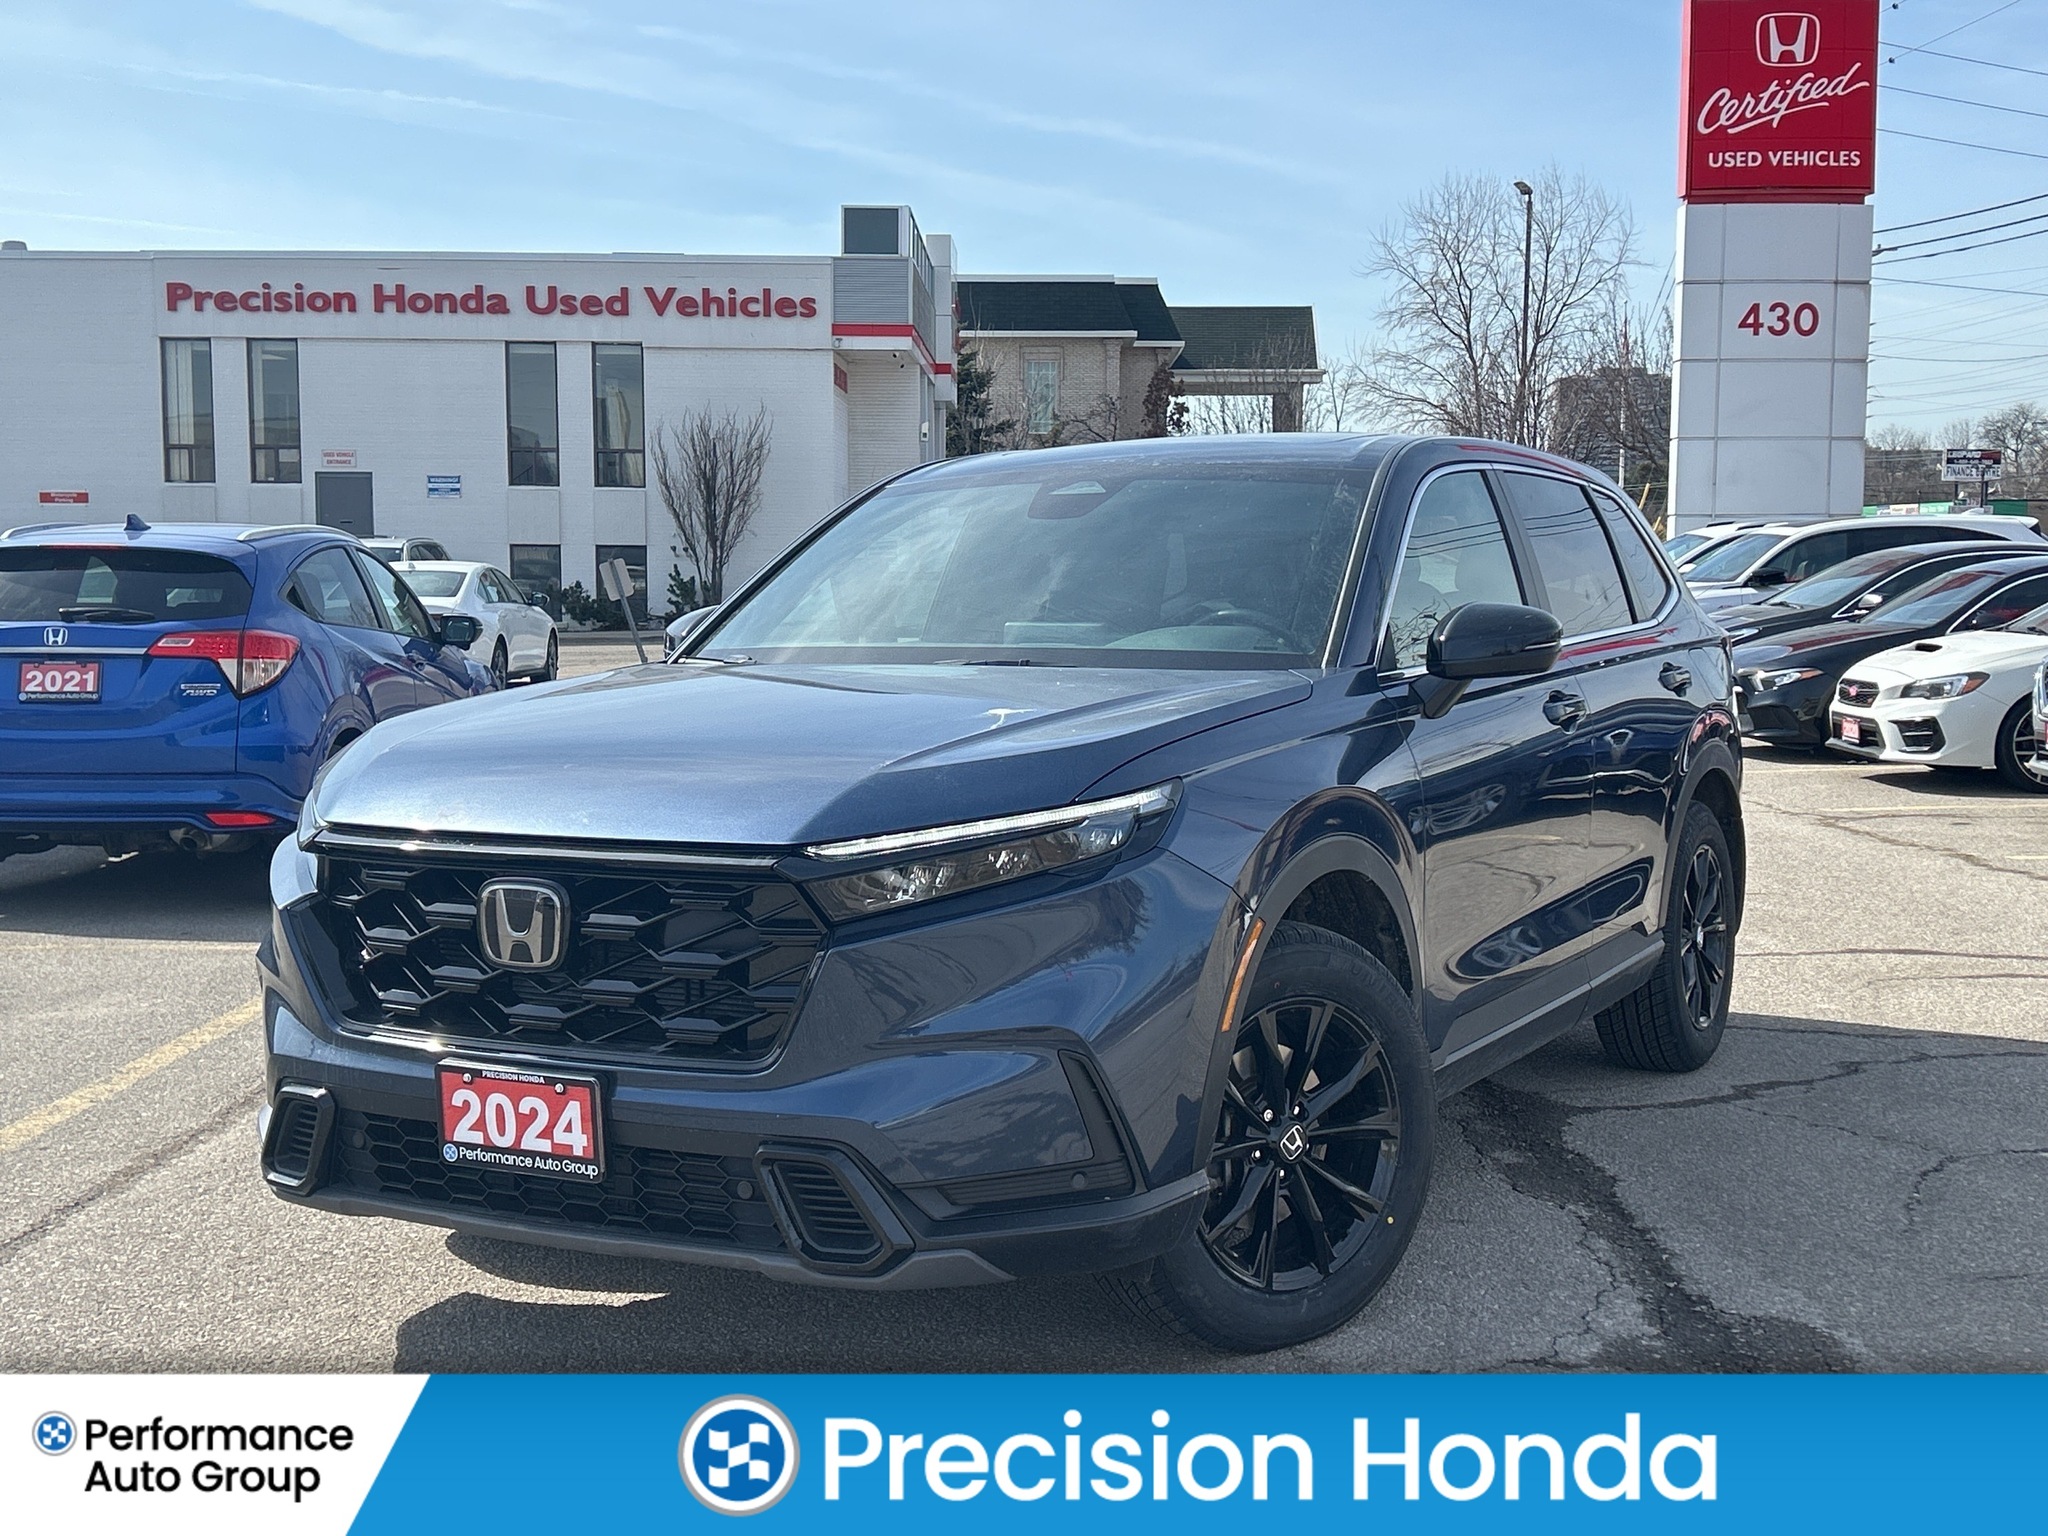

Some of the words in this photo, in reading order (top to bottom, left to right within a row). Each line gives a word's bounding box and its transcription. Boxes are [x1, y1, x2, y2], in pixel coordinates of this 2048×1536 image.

[1697, 62, 1870, 134] Certified
[1708, 152, 1762, 168] USED
[1768, 151, 1861, 167] VEHICLES
[165, 282, 357, 313] Precision
[372, 284, 509, 314] Honda
[525, 285, 630, 317] Used
[644, 287, 817, 318] Vehicles
[1738, 302, 1819, 336] 430
[1946, 466, 1974, 477] FINANCE
[25, 670, 95, 692] 2021
[80, 692, 98, 700] Group
[481, 1070, 518, 1081] PRECISION
[518, 1073, 546, 1084] HONDA
[451, 1089, 588, 1156] 2024
[459, 1147, 533, 1168] Performance
[534, 1155, 561, 1172] Auto
[562, 1160, 599, 1179] Group
